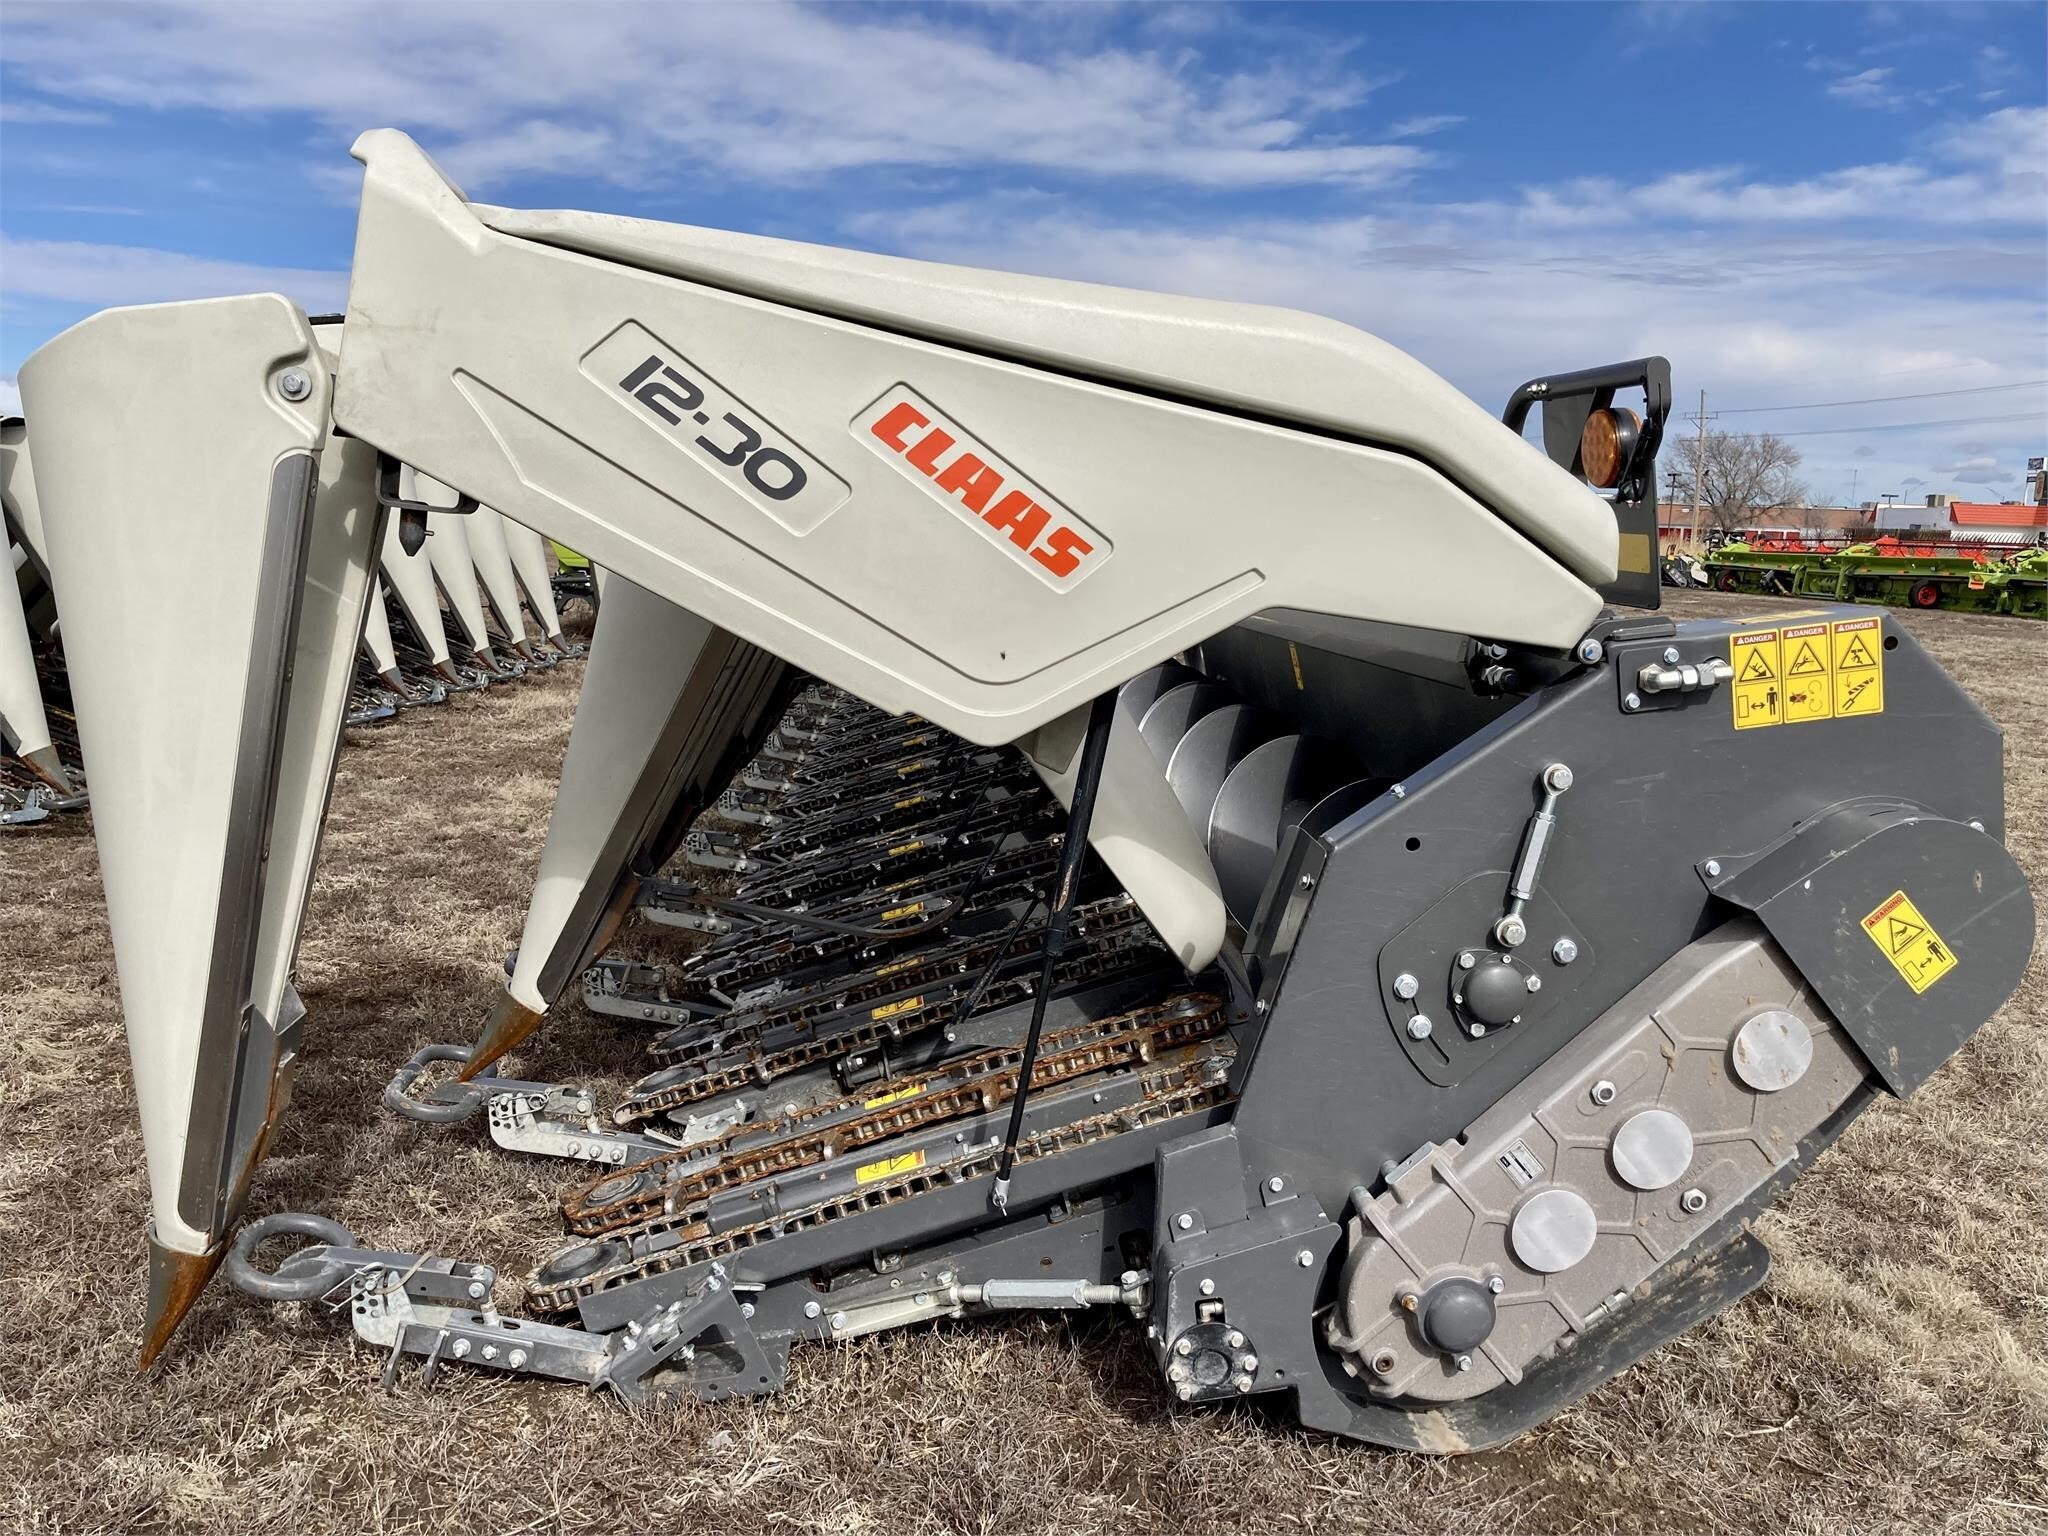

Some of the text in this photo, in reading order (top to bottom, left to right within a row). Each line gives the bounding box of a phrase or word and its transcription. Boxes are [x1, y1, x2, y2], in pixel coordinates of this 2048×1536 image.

[870, 401, 1094, 578] CLAAS
[1844, 621, 1874, 631] DANGER
[1794, 627, 1824, 637] DANGER
[1744, 634, 1774, 644] DANGER
[1873, 896, 1903, 921] WARNING
